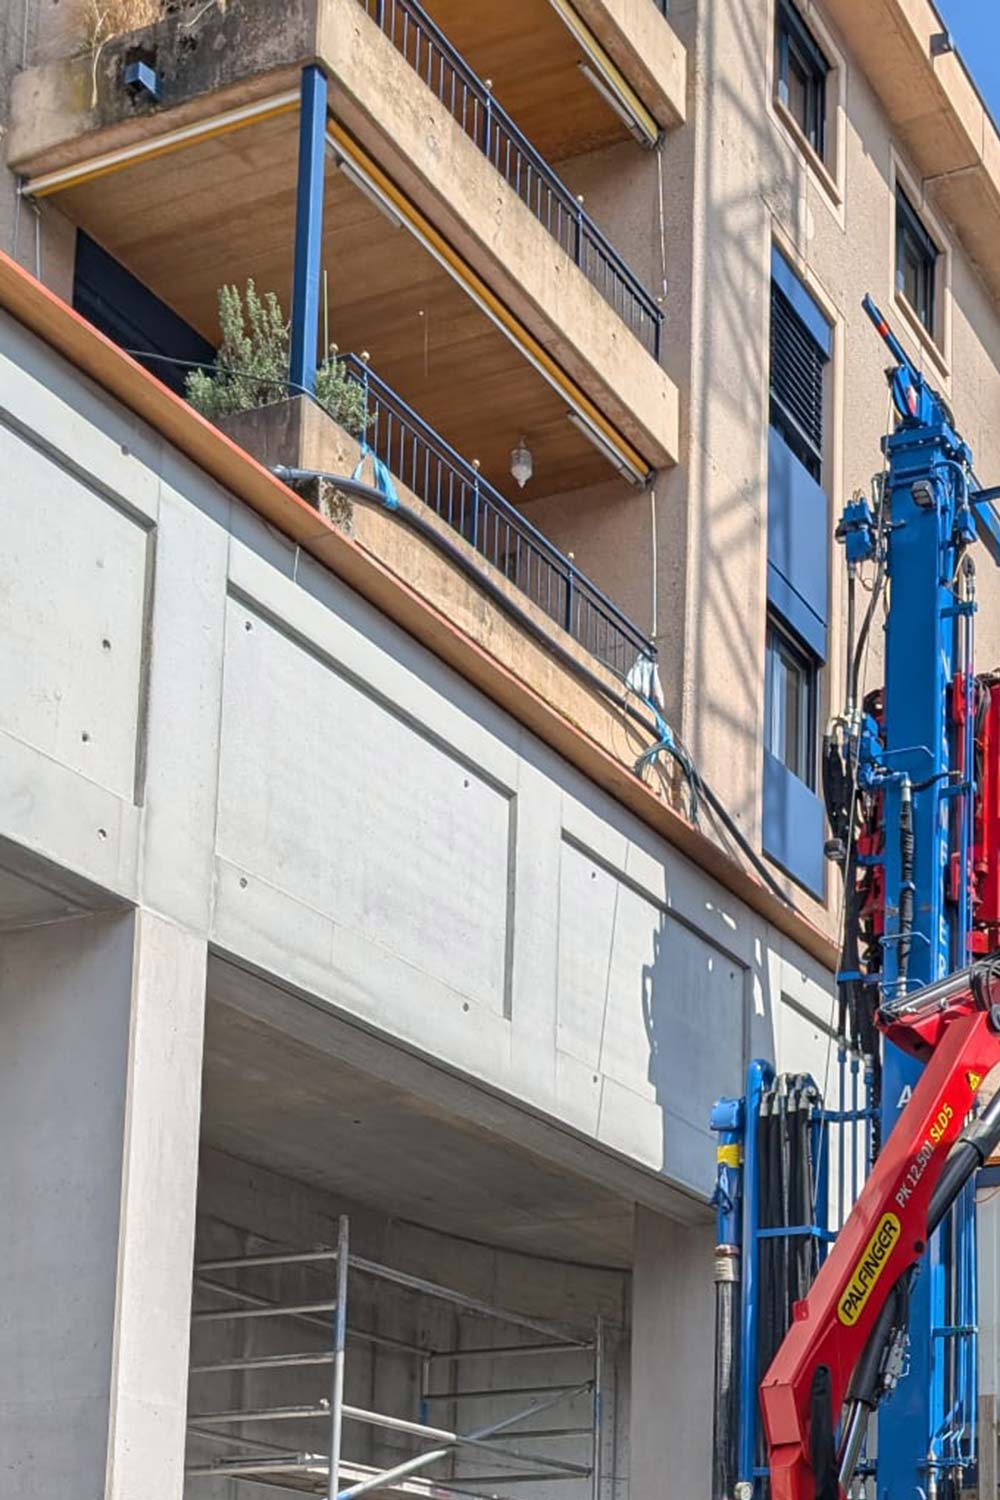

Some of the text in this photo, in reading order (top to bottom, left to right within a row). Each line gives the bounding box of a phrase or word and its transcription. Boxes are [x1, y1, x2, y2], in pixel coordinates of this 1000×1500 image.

[895, 1182, 913, 1208] PK
[929, 1103, 954, 1143] SLD5
[841, 1219, 899, 1320] PALFINGER
